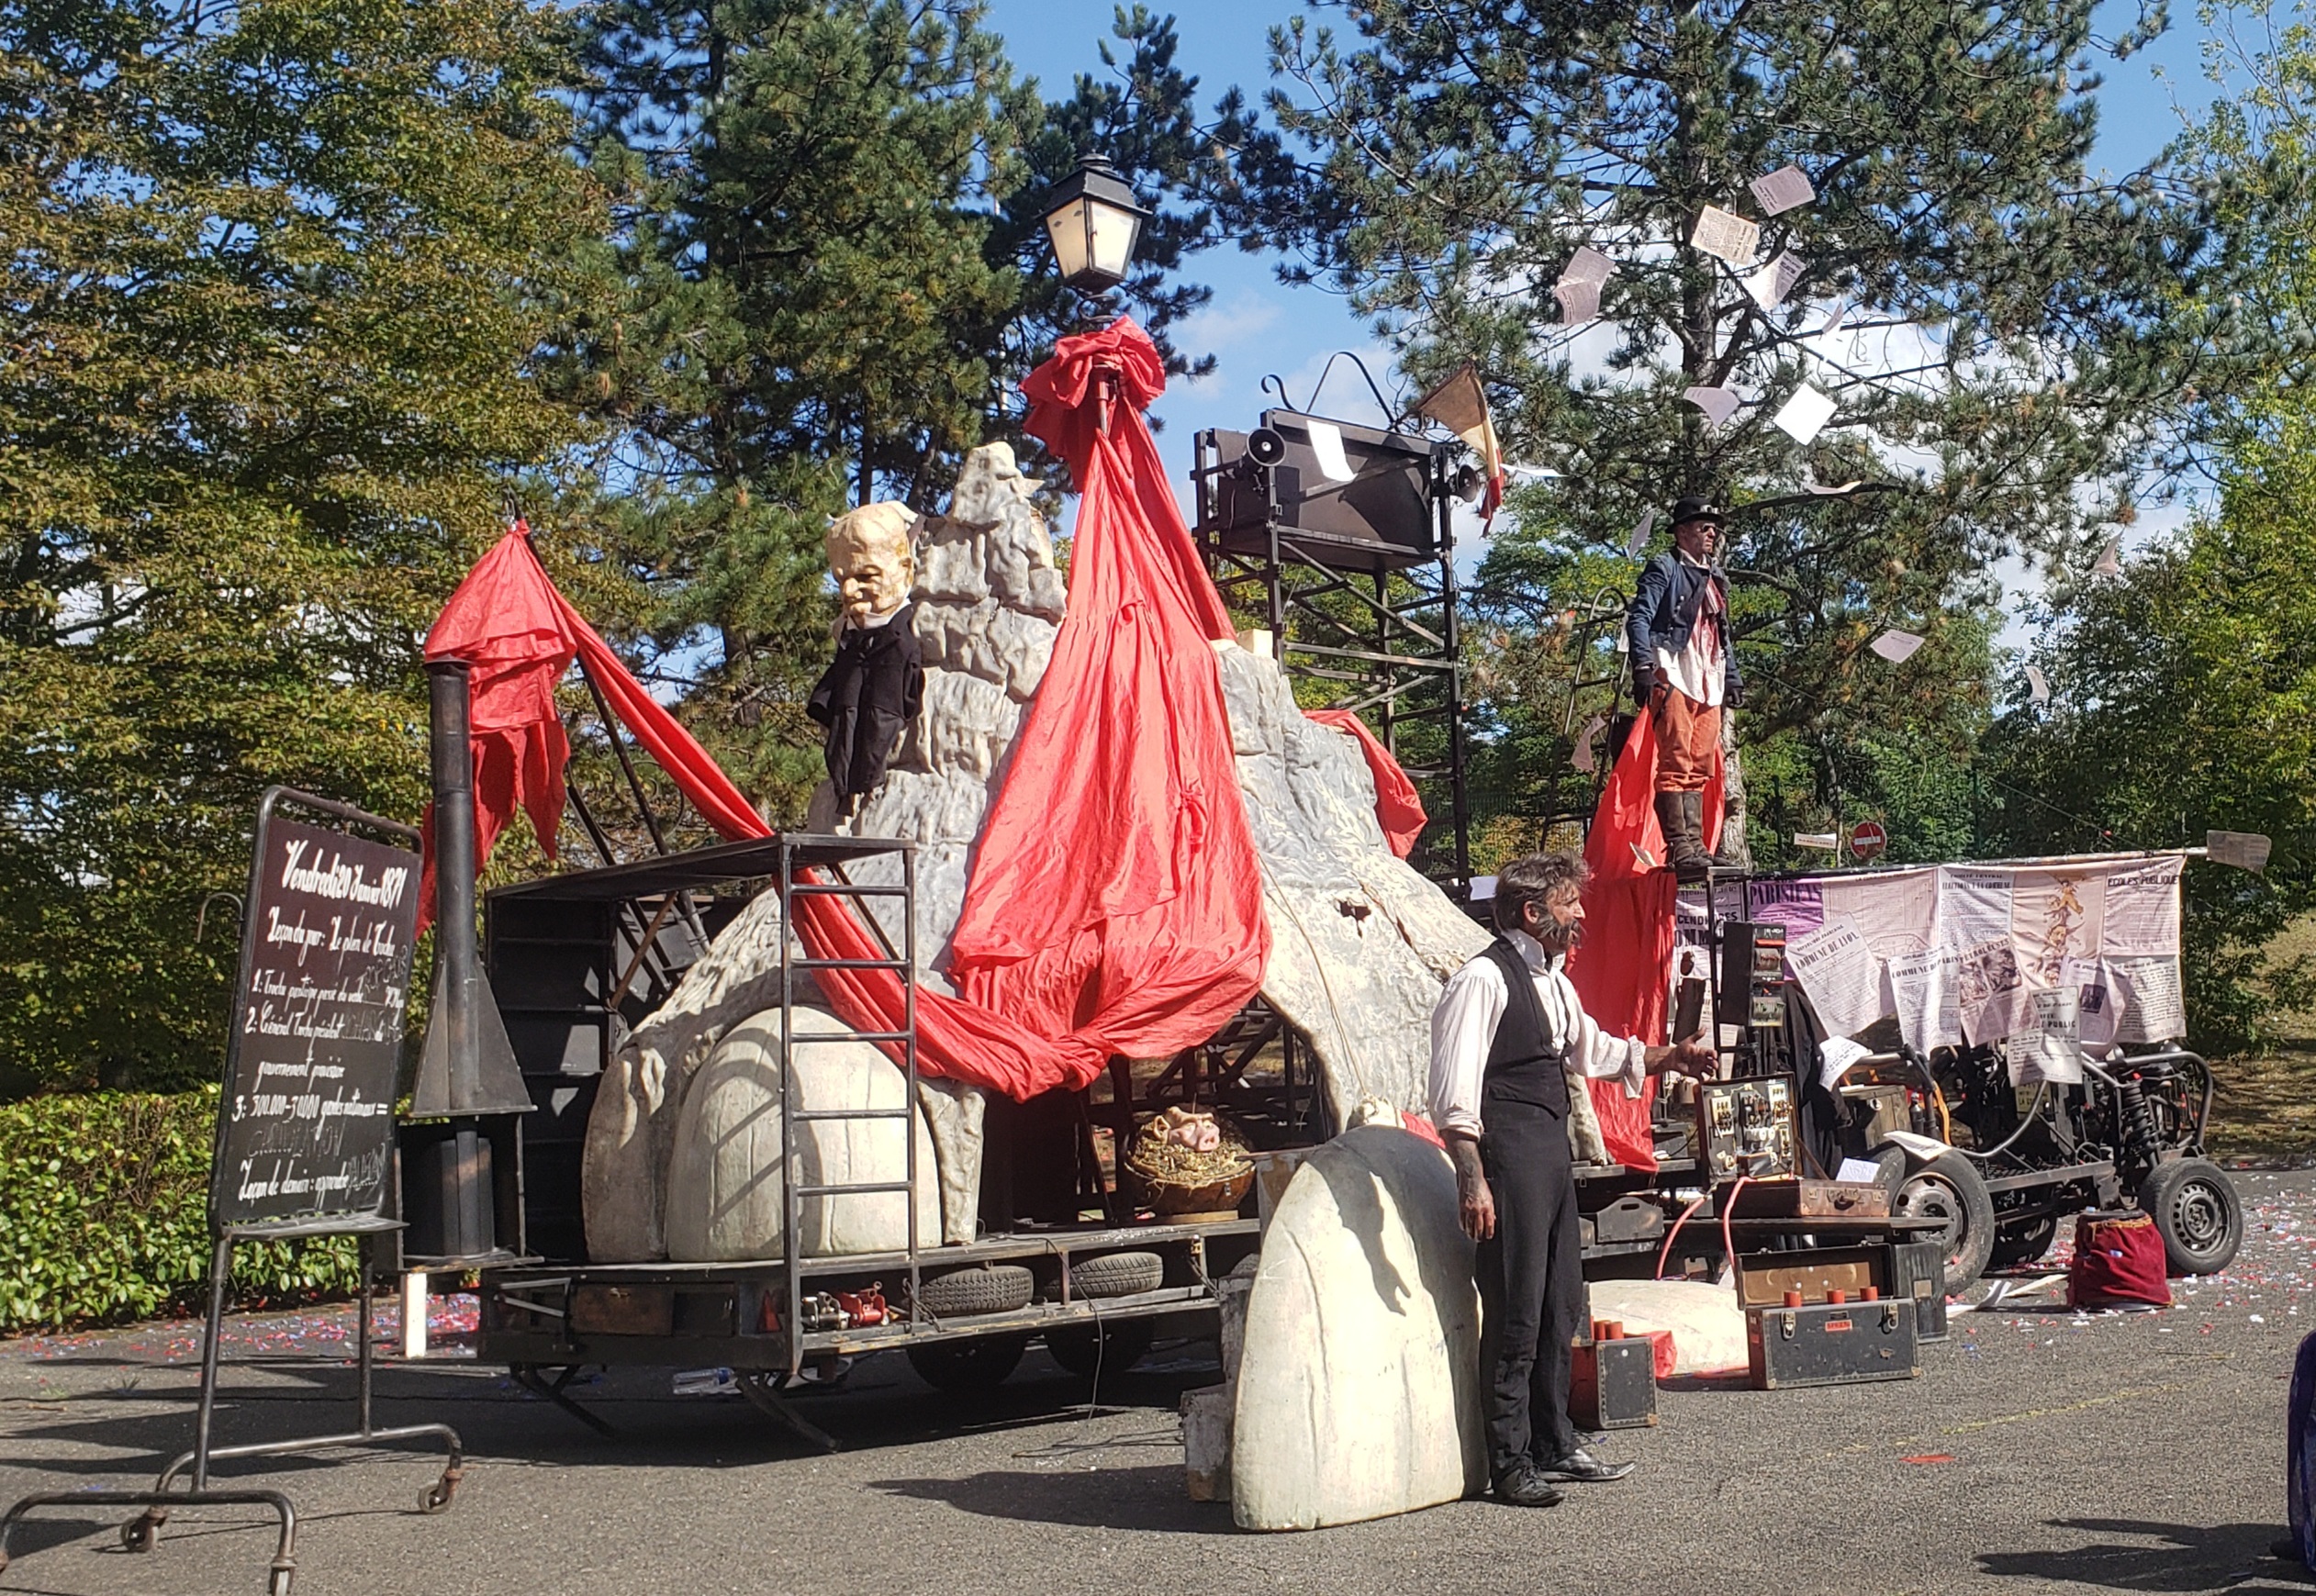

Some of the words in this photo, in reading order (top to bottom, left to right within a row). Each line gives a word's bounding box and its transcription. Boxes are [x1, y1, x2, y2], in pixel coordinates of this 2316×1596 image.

[282, 839, 340, 899] Vendredi
[336, 864, 352, 899] 20
[349, 865, 382, 905] Janvier
[380, 866, 408, 910] 1871
[294, 909, 307, 943] du
[329, 915, 342, 951] Le
[362, 921, 373, 954] de
[1827, 940, 1840, 954] DE
[1892, 965, 1929, 979] COMMUNE
[268, 1158, 281, 1196] de
